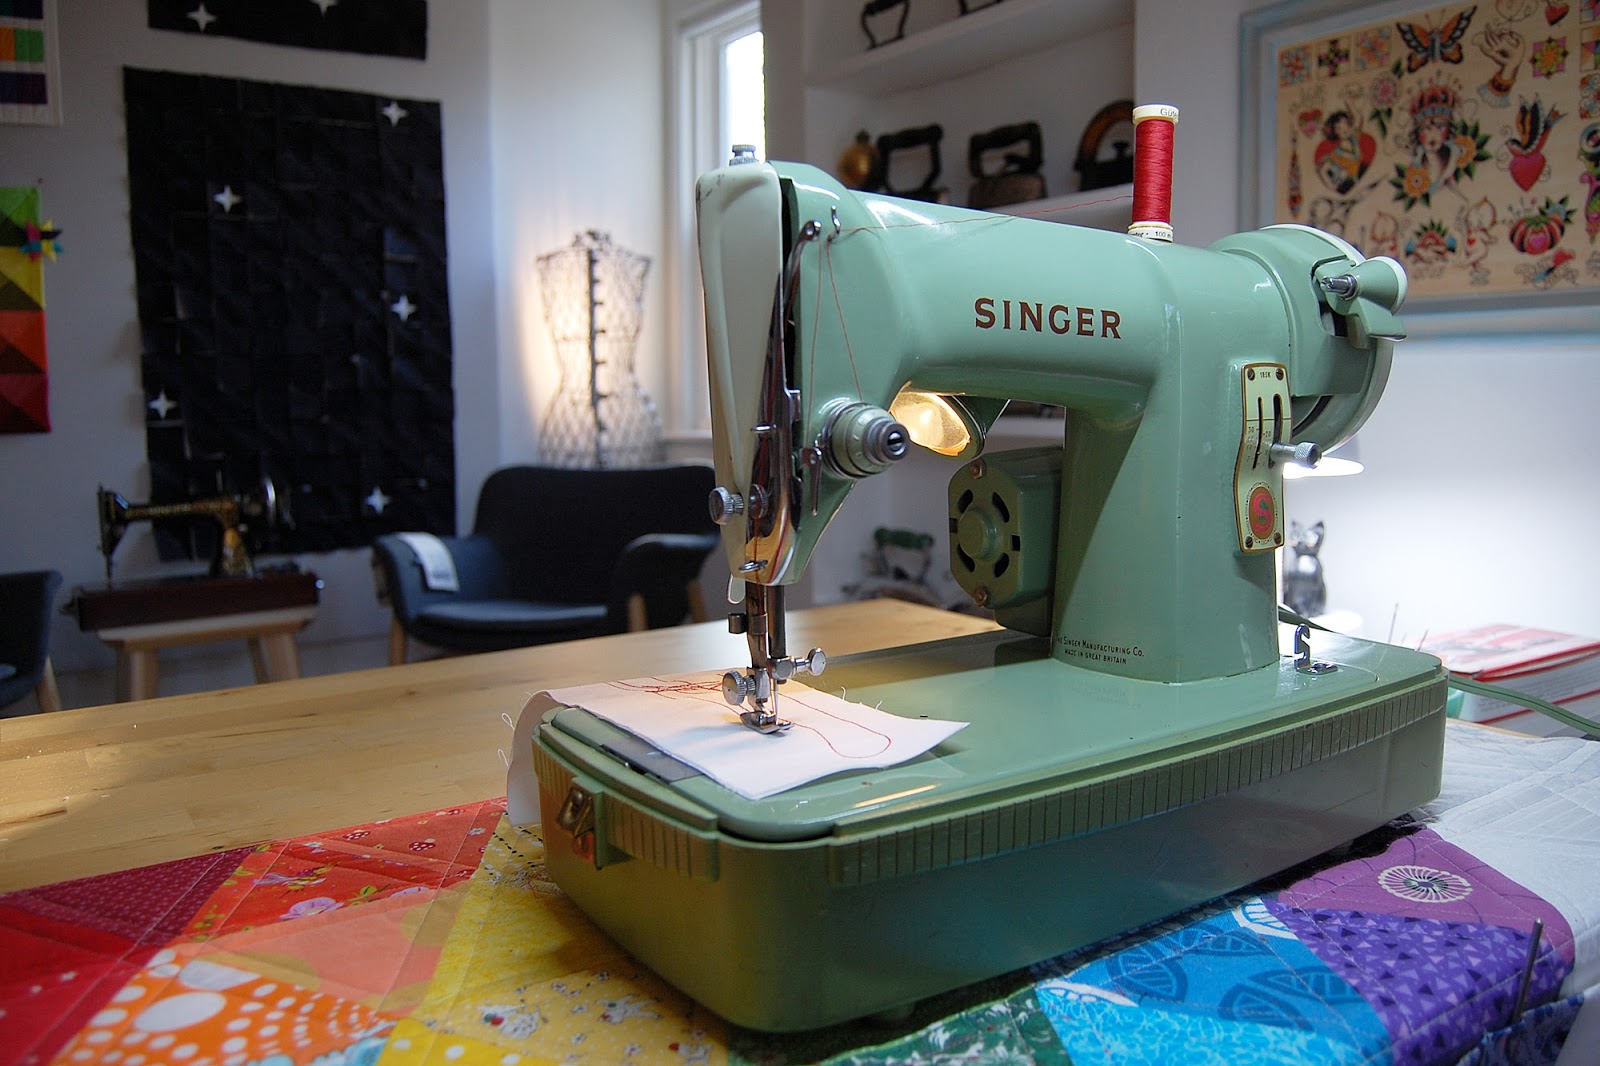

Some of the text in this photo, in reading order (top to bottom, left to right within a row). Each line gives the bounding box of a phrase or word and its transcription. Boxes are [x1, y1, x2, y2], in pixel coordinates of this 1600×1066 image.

[974, 297, 1121, 340] SINGER
[1084, 652, 1101, 661] GREAT
[1103, 654, 1127, 665] BRITAIN
